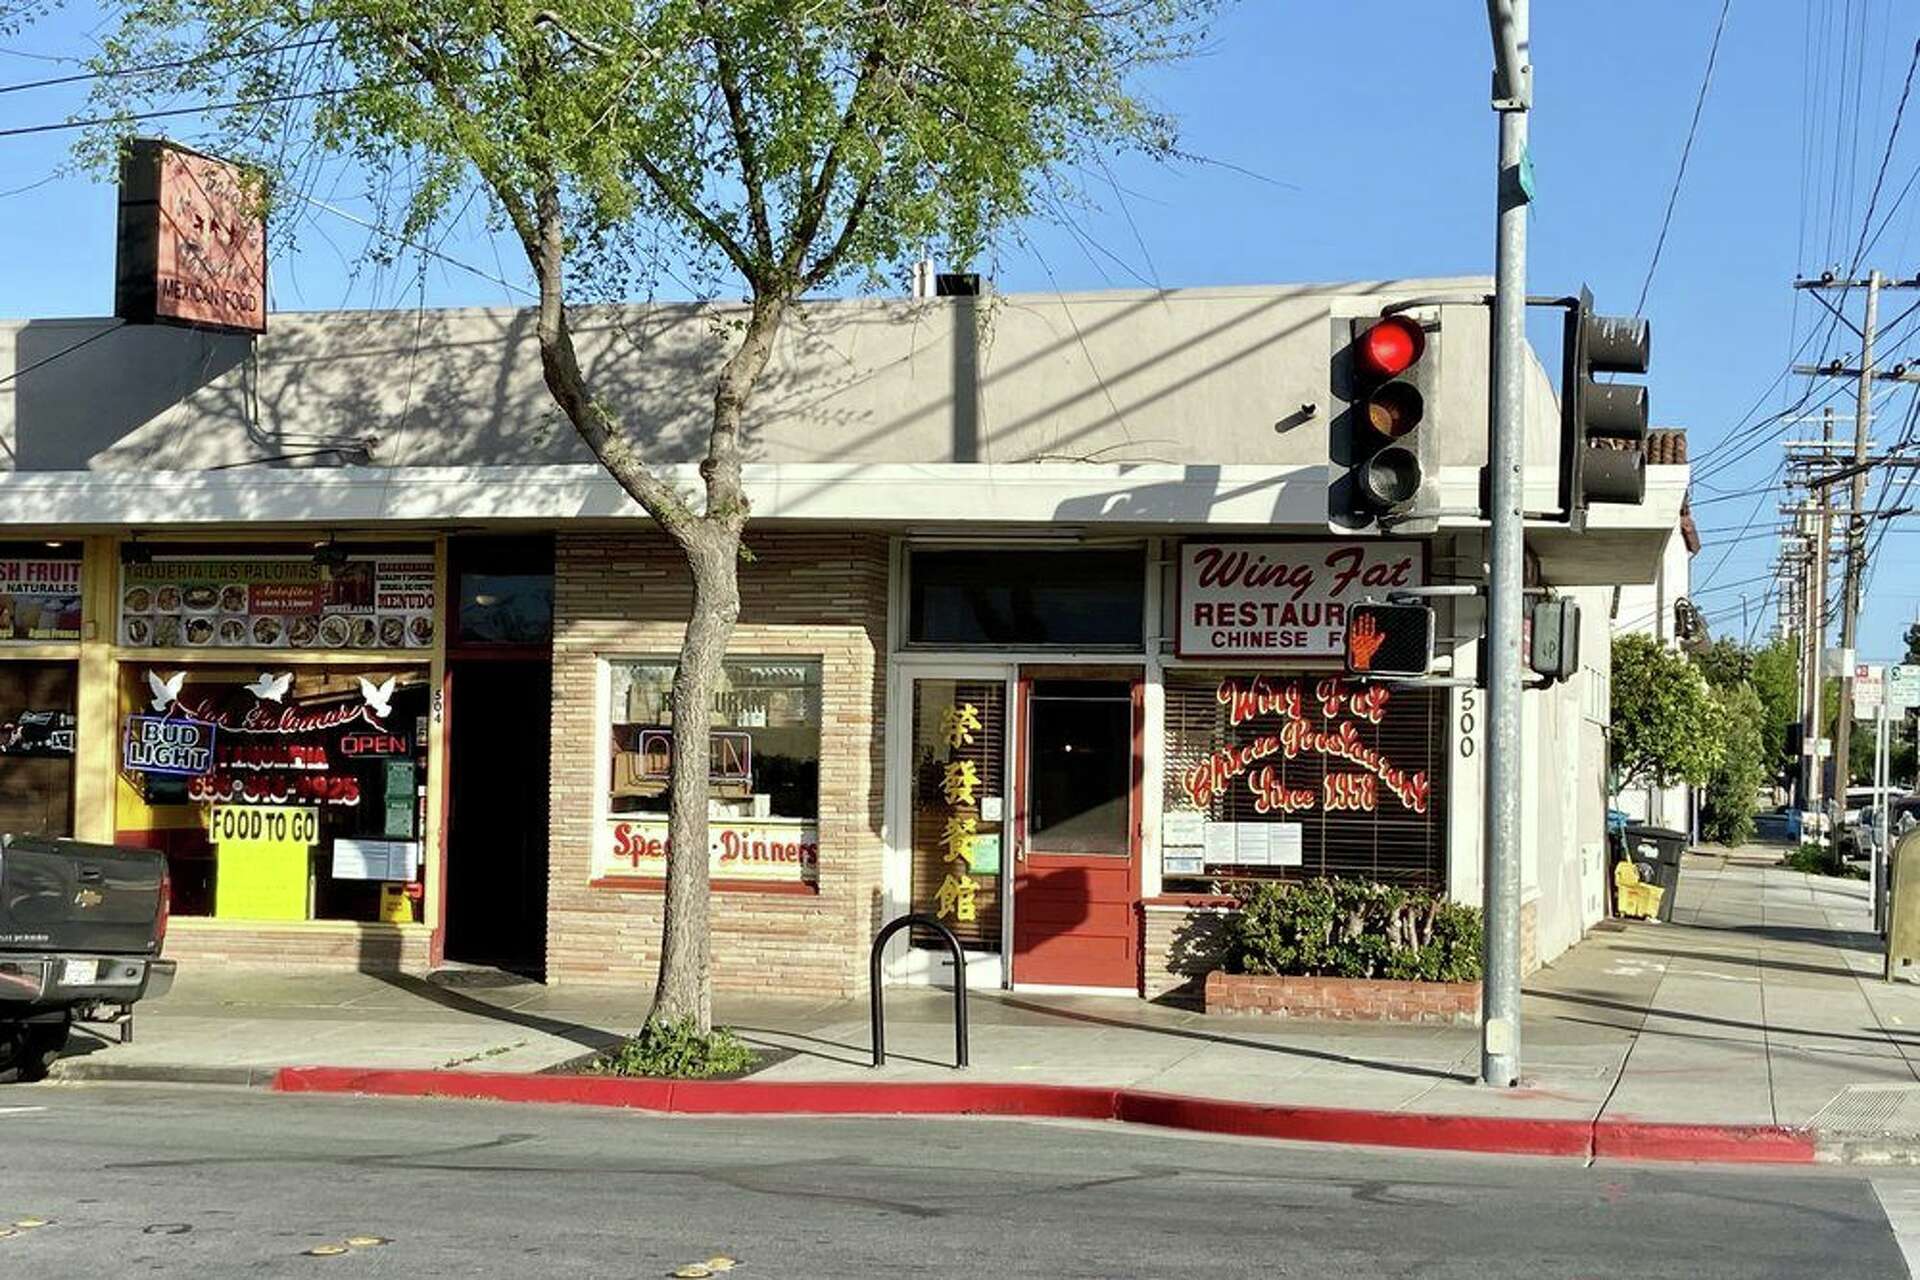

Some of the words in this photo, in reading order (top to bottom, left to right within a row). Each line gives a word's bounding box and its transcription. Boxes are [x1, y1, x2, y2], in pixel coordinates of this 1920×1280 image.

[163, 278, 220, 307] MEXICAN
[223, 289, 257, 312] FOOD
[7, 583, 78, 593] NATURALES
[27, 562, 82, 582] FRUIT
[208, 564, 240, 579] LAS
[1194, 547, 1316, 601] Wing
[1325, 546, 1412, 597] Fat
[1194, 602, 1346, 627] RESTAUR
[1211, 631, 1308, 649] CHINESE
[434, 690, 443, 724] 504
[1217, 674, 1301, 725] Wing
[1316, 677, 1389, 724] Fat
[142, 721, 199, 746] BUD
[1460, 689, 1475, 758] 500
[130, 741, 210, 770] LIGHT
[341, 736, 407, 754] OPEN
[644, 735, 748, 777] ON
[1280, 718, 1429, 813] Restaurant
[1249, 766, 1315, 813] Since
[212, 809, 261, 839] FOOD
[266, 811, 285, 841] TO
[292, 812, 314, 841] GO
[614, 822, 672, 867] Spec
[720, 830, 818, 863] Dinners
